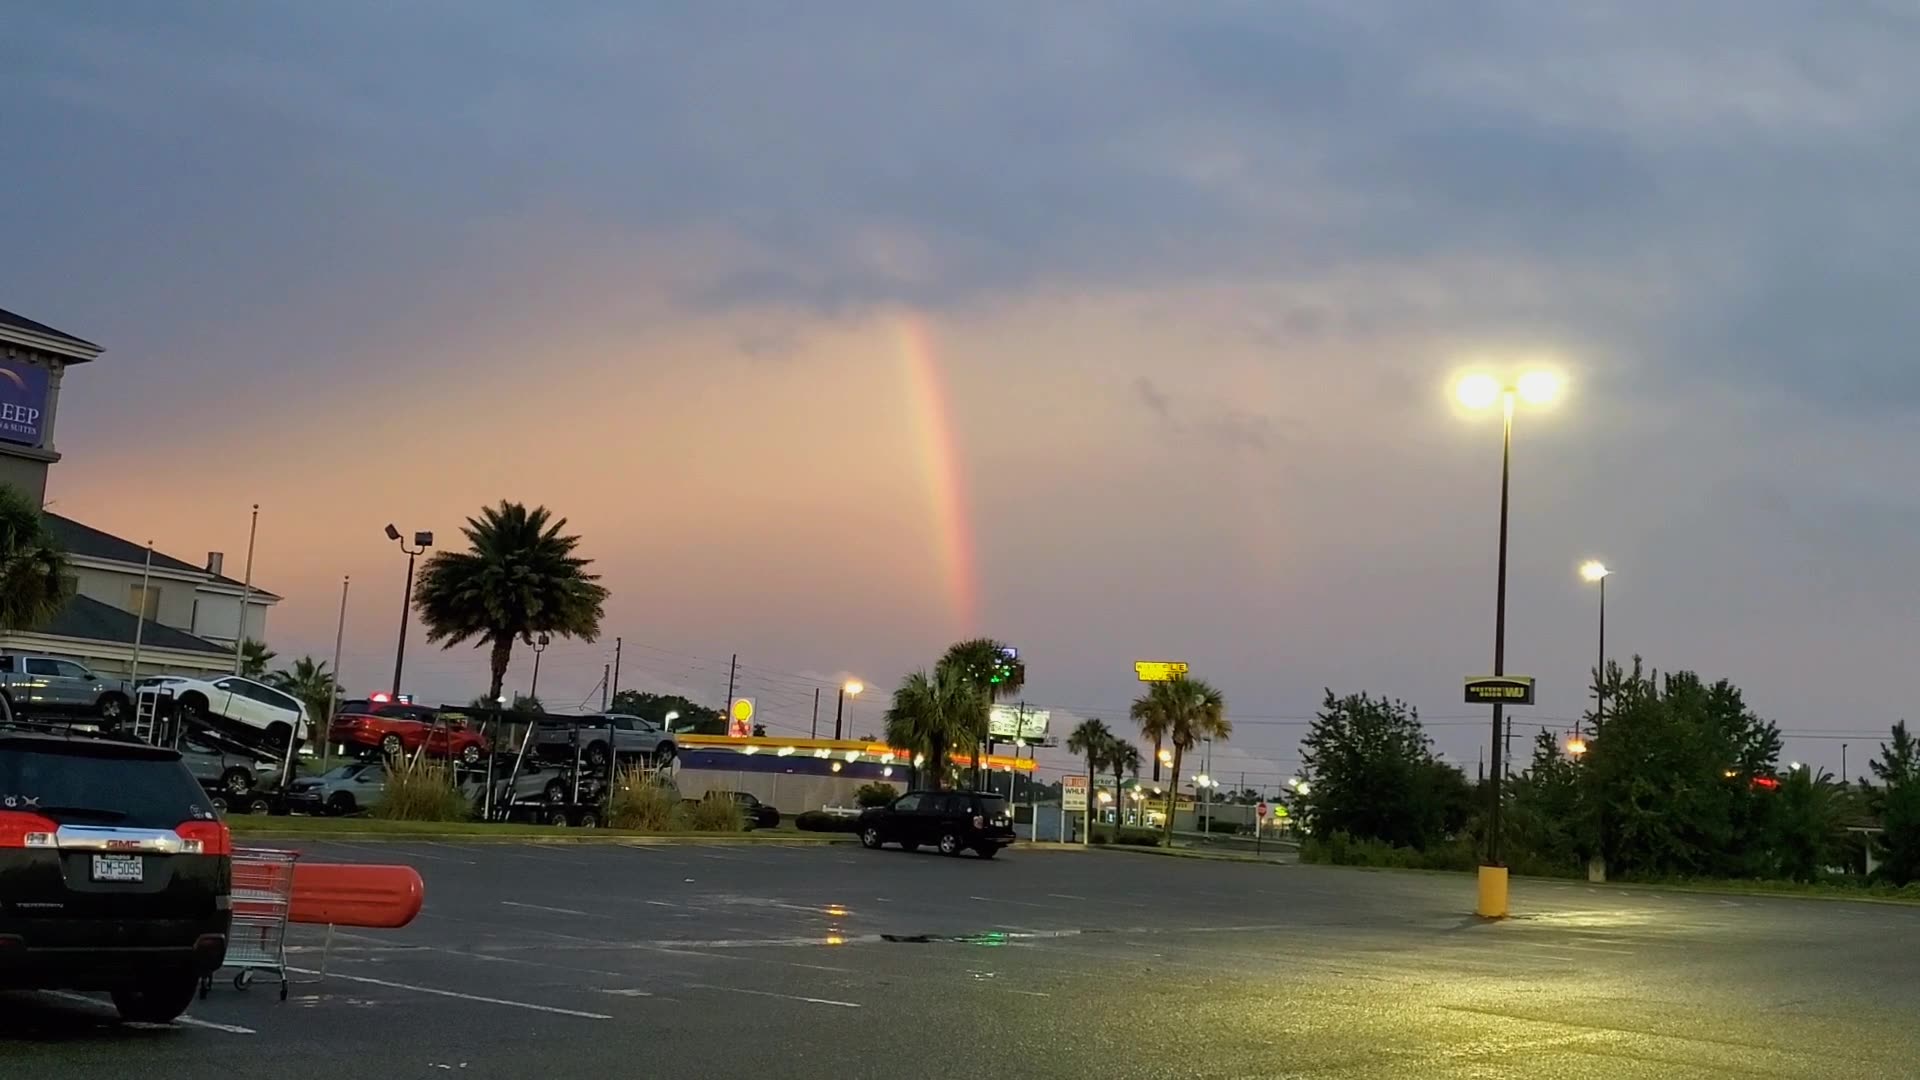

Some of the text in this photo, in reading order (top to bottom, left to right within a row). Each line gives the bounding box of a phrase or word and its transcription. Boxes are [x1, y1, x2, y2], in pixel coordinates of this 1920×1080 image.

[0, 402, 40, 424] EEP
[107, 839, 141, 849] GMC
[94, 860, 142, 876] FCM-5095
